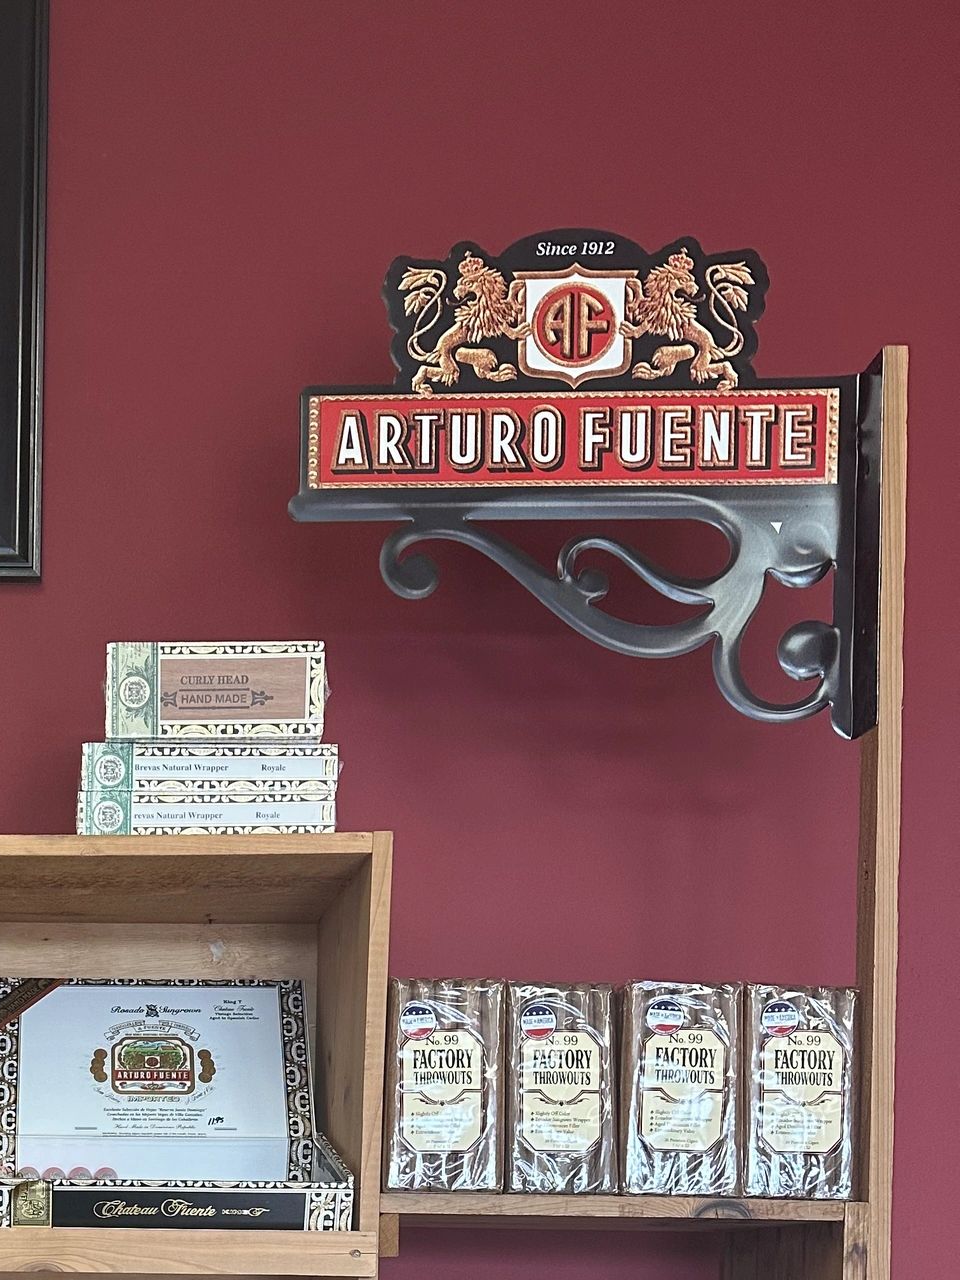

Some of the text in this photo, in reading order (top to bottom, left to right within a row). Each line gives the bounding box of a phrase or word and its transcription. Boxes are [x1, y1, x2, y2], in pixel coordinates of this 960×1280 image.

[536, 240, 615, 256] Since 1912
[333, 404, 818, 472] ARTURO FUENTE
[180, 674, 249, 686] CURLY HEAD
[181, 693, 247, 705] HAND MADE
[162, 762, 191, 771] Natural
[193, 763, 229, 774] Wrapper
[261, 762, 286, 773] Royale
[134, 810, 280, 822] revas Natural Wrapper Royale
[110, 1005, 202, 1016] Rosado Sungrown
[444, 1035, 459, 1045] 99
[563, 1035, 578, 1045] 99
[688, 1033, 703, 1044] 99
[806, 1035, 821, 1046] 99
[413, 1049, 473, 1069] FACTORY
[533, 1049, 592, 1069] FACTORY
[655, 1047, 717, 1068] FACTORY
[774, 1049, 835, 1070] FACTORY
[117, 1071, 188, 1080] ARTURO FUENTE
[414, 1071, 472, 1085] THROWOUTS
[533, 1071, 591, 1085] THROWOUTS
[655, 1069, 715, 1084] THROWOUTS
[775, 1071, 833, 1086] THROWOUTS
[93, 1199, 218, 1218] Chateau Fuente
